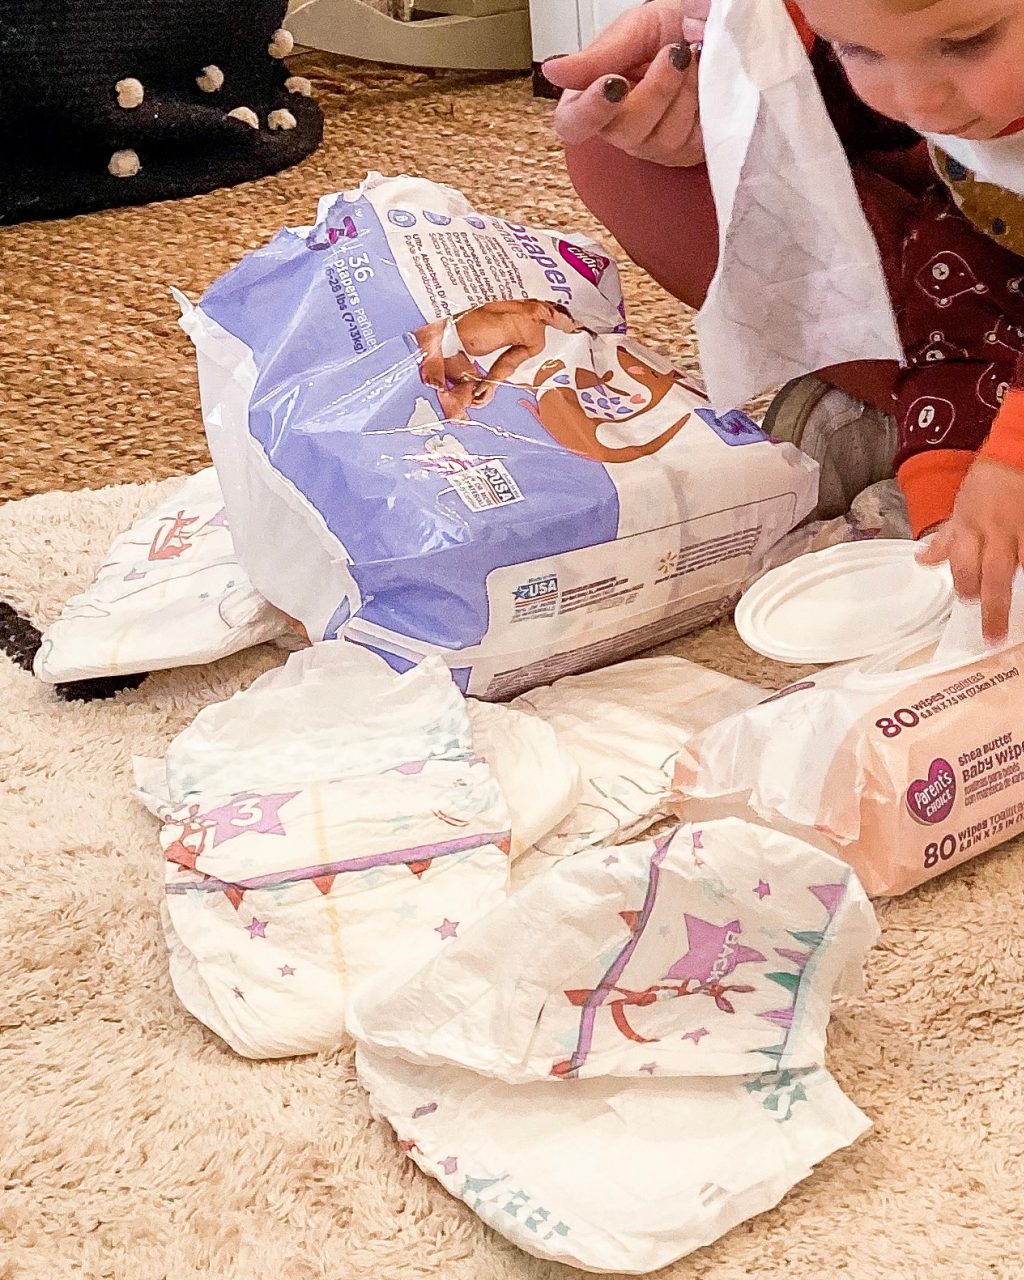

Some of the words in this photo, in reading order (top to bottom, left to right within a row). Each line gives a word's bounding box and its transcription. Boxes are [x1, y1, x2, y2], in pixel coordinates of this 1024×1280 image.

[349, 252, 375, 282] 36
[420, 253, 443, 290] Absorbent
[504, 221, 572, 305] Diaper
[567, 246, 599, 276] CHOIC
[334, 259, 361, 305] Diapers
[335, 293, 348, 311] lbs
[342, 312, 367, 355] (7-13kg)
[492, 474, 515, 502] USA
[529, 579, 557, 597] USA
[875, 708, 920, 738] 80
[962, 756, 994, 783] Baby
[230, 798, 263, 827] 3
[926, 789, 952, 817] CHOICE
[924, 834, 956, 869] 80
